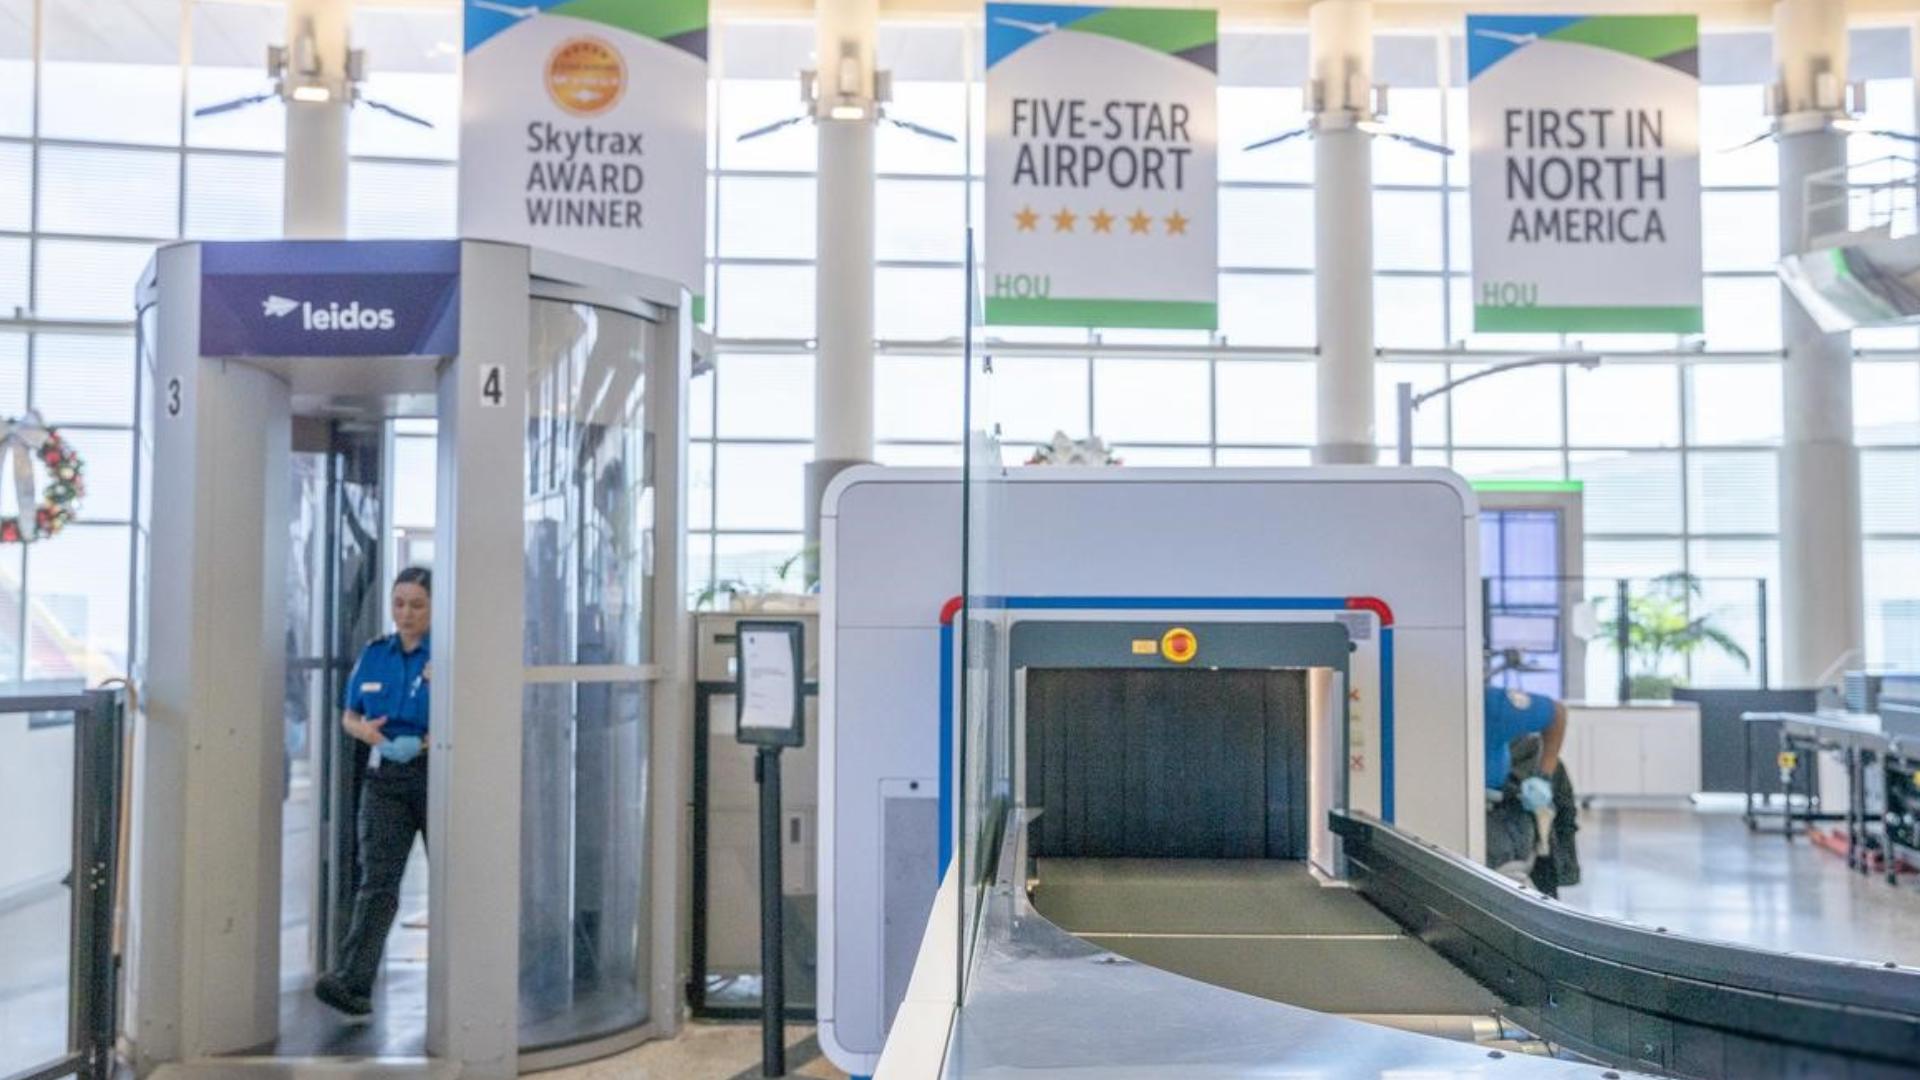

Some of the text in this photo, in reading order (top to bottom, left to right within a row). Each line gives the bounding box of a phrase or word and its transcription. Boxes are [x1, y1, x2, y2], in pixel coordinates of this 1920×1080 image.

[1012, 98, 1191, 142] FIVE-STAR
[1505, 108, 1664, 149] FIRST IN
[526, 121, 643, 161] Skytrax
[526, 162, 644, 194] AWARD
[1012, 143, 1192, 190] AIRPORT
[1506, 157, 1667, 200] NORTH
[525, 199, 644, 228] WINNER
[1508, 208, 1666, 243] AMERICA
[994, 275, 1050, 298] HOU
[1482, 283, 1538, 306] HOU
[303, 302, 395, 331] leidos
[168, 379, 181, 415] 3
[483, 367, 503, 403] 4
